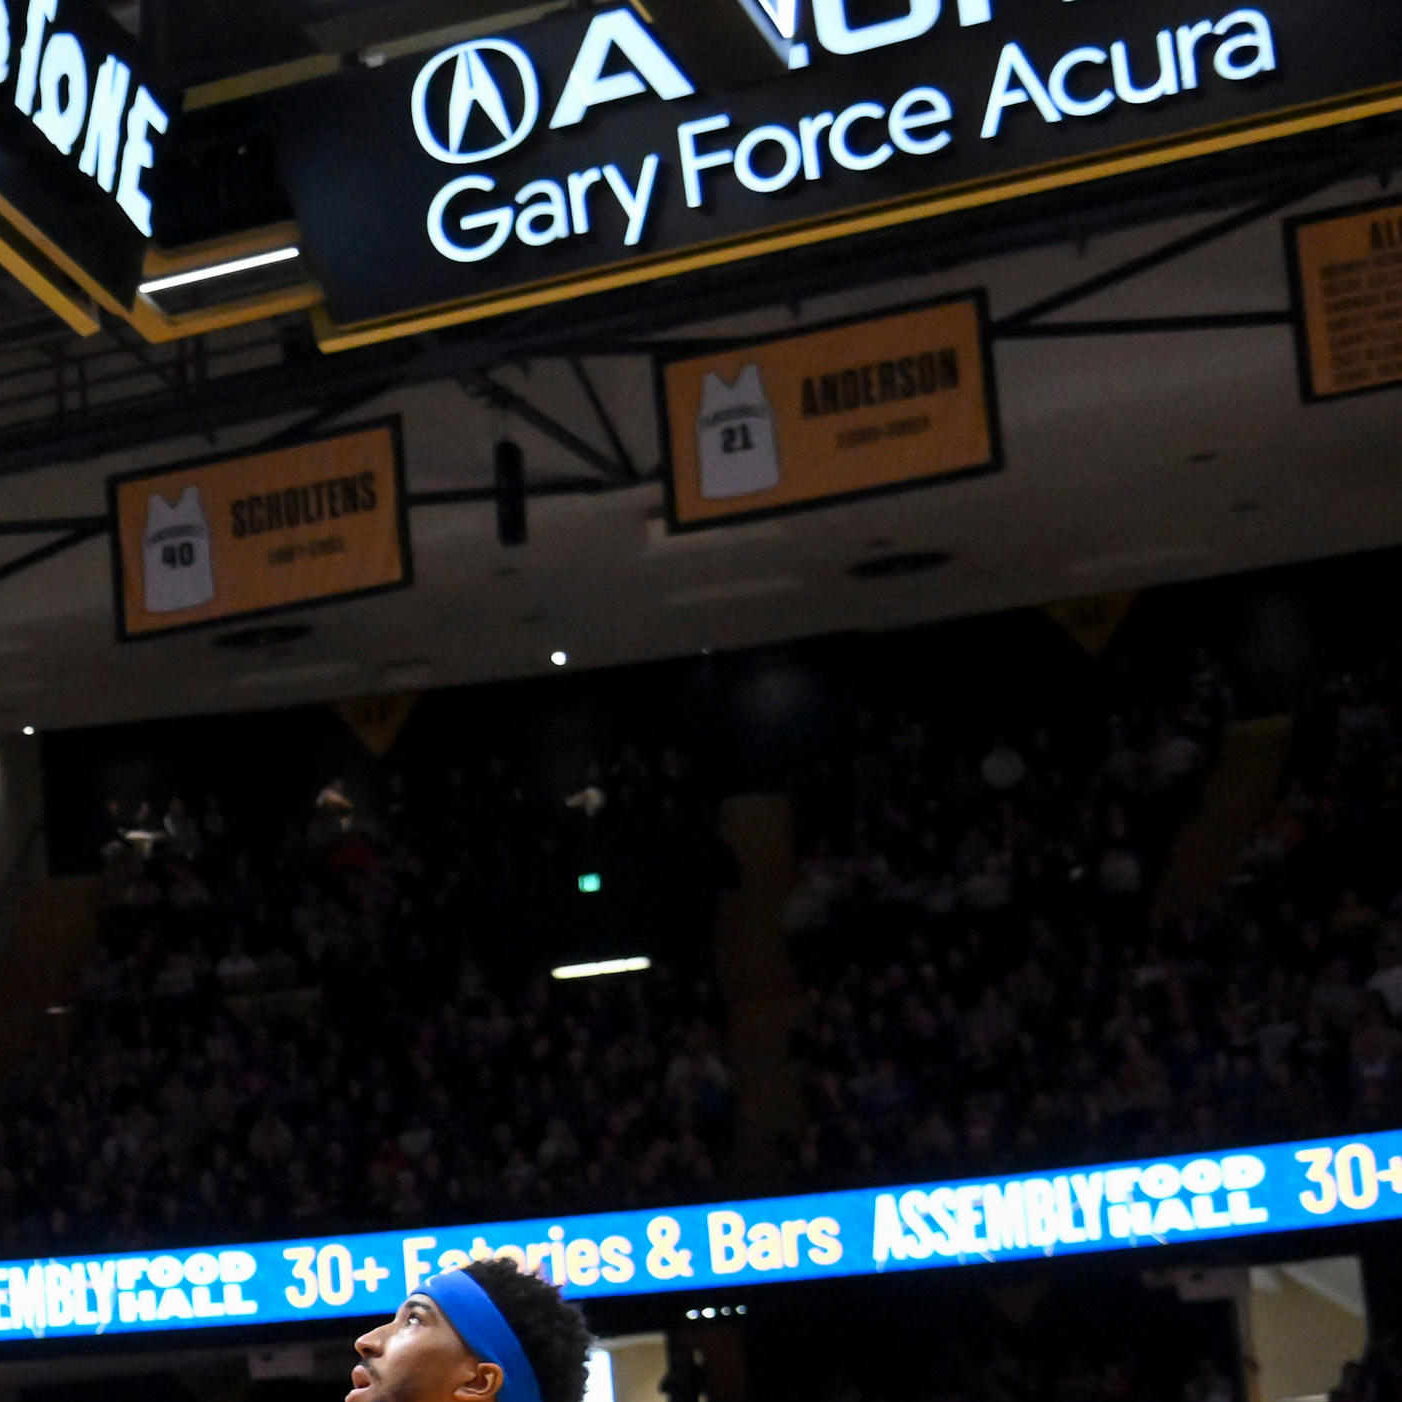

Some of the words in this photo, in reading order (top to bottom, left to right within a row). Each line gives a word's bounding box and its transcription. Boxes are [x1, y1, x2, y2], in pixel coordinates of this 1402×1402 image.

[426, 153, 659, 263] Gary
[678, 87, 953, 209] Force
[979, 8, 1277, 139] Acura
[801, 346, 960, 418] ANDERSON
[720, 422, 753, 454] 21
[229, 471, 377, 538] SCHOLTENS
[160, 540, 196, 569] 40
[872, 1174, 1105, 1264] ASSEMBLY
[1102, 1154, 1266, 1204] FOOD
[1296, 1143, 1402, 1215] 30+
[1107, 1193, 1269, 1239] HALL
[117, 1250, 257, 1291] FOOD
[283, 1244, 389, 1309] 30+
[645, 1216, 694, 1281] &
[707, 1211, 843, 1276] Bars
[118, 1282, 257, 1323] HALL
